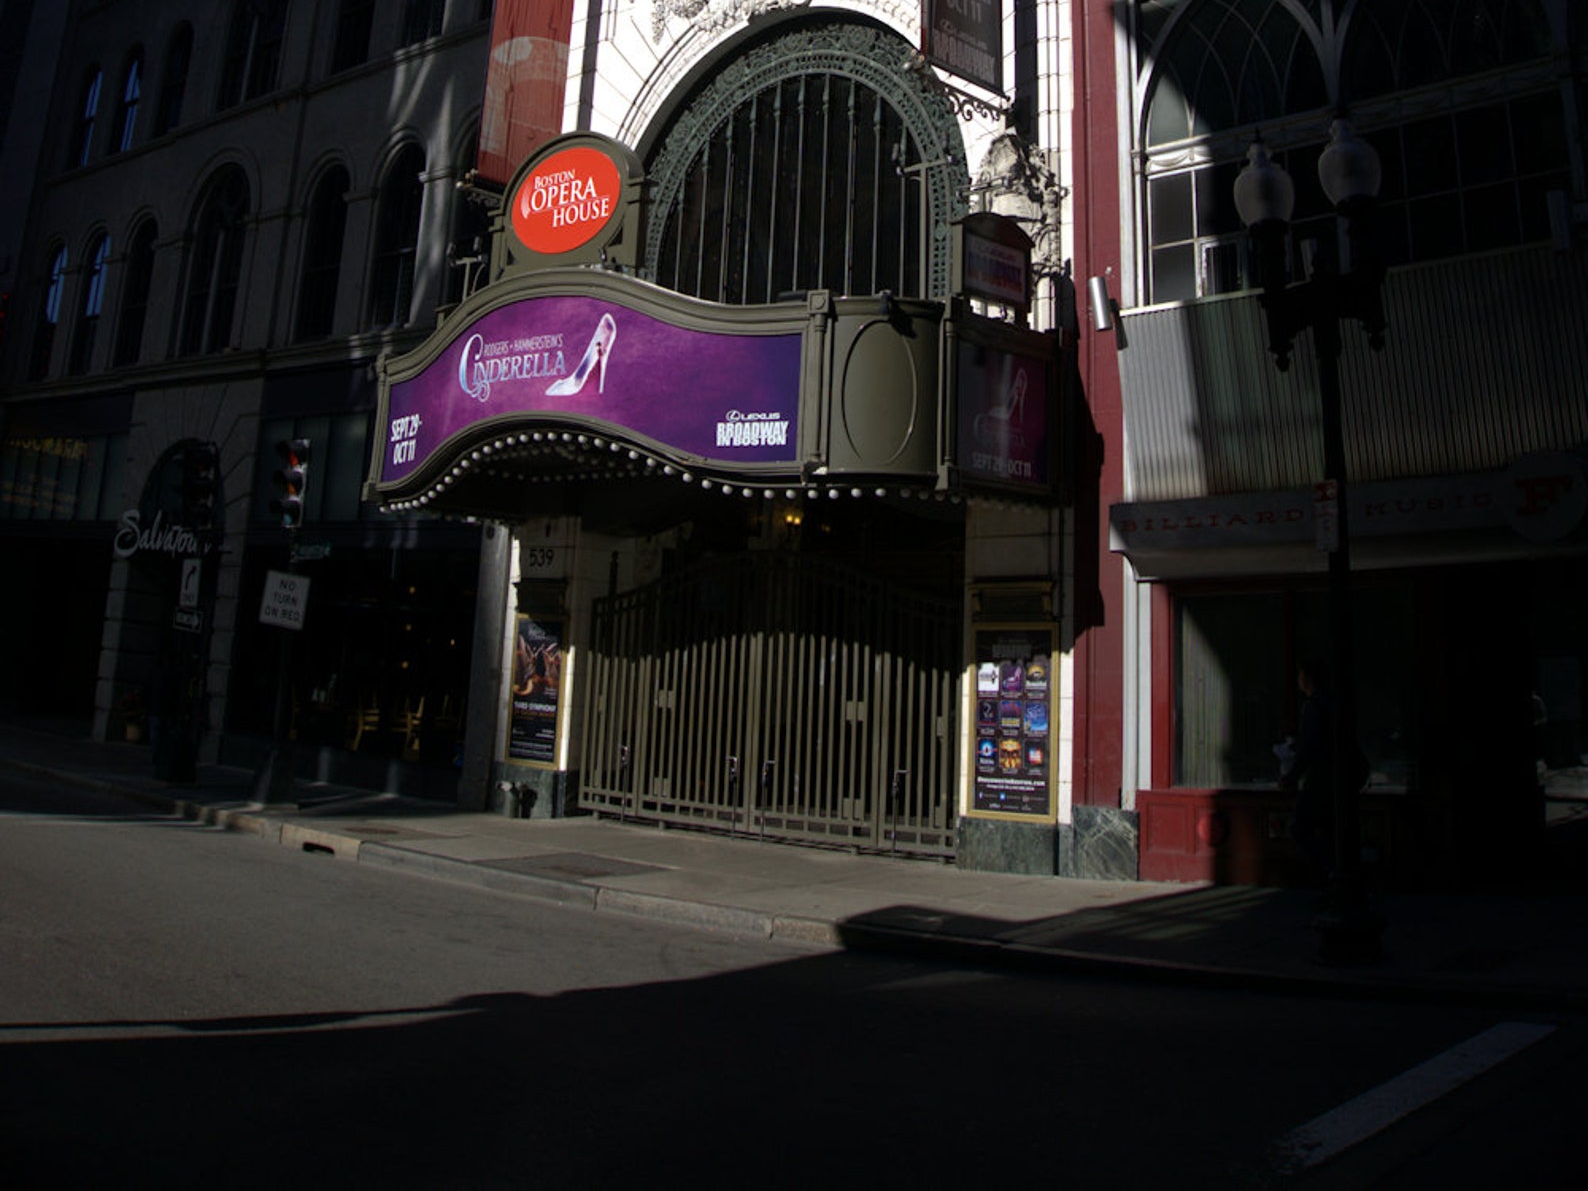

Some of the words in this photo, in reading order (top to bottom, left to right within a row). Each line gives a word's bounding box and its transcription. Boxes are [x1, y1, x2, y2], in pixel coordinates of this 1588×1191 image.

[971, 0, 982, 23] 11
[534, 169, 576, 190] BOSTON
[531, 176, 597, 212] OPERA
[552, 198, 609, 228] HOUSE
[459, 333, 567, 402] CINDERELLA
[716, 420, 789, 439] BROADWAY
[733, 435, 788, 447] BOSTON
[1121, 508, 1318, 533] BILLIARD
[529, 548, 554, 567] 539
[279, 579, 297, 592] NO
[264, 605, 279, 618] ON
[281, 609, 300, 622] RED
